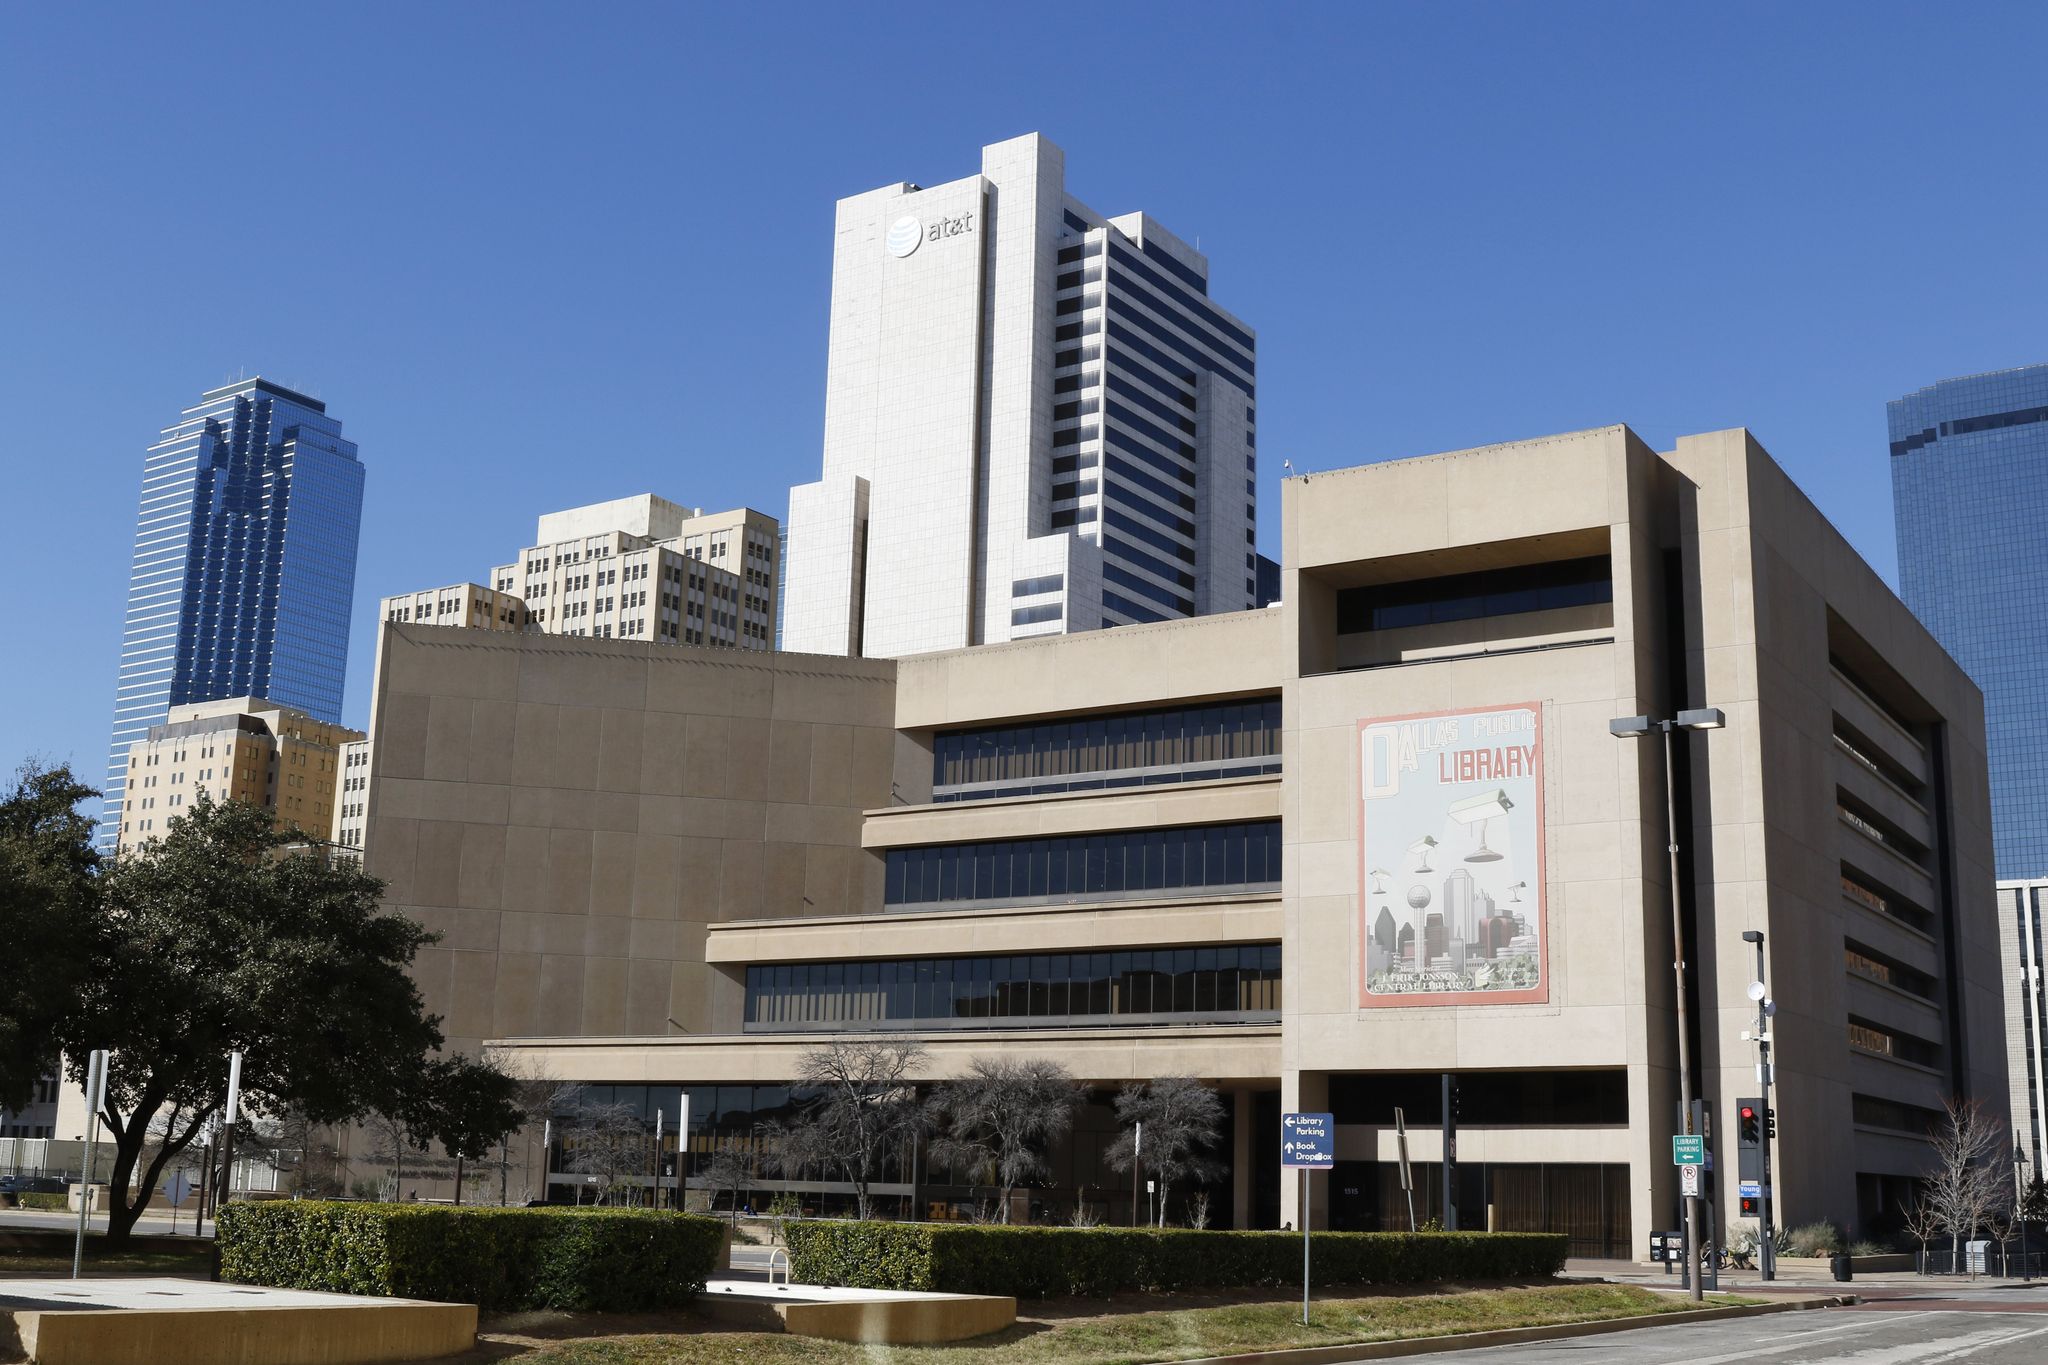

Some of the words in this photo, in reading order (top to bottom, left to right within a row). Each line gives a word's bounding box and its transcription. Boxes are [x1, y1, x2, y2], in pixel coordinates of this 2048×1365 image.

[928, 212, 973, 241] at&t
[1362, 719, 1459, 800] DALLAS
[1473, 713, 1536, 738] PUBLIC
[1439, 744, 1537, 784] LIBRARY
[1423, 980, 1466, 991] LIBRARY
[1296, 1117, 1323, 1126] Library
[1296, 1127, 1325, 1137] Parking
[1296, 1141, 1316, 1150] Book
